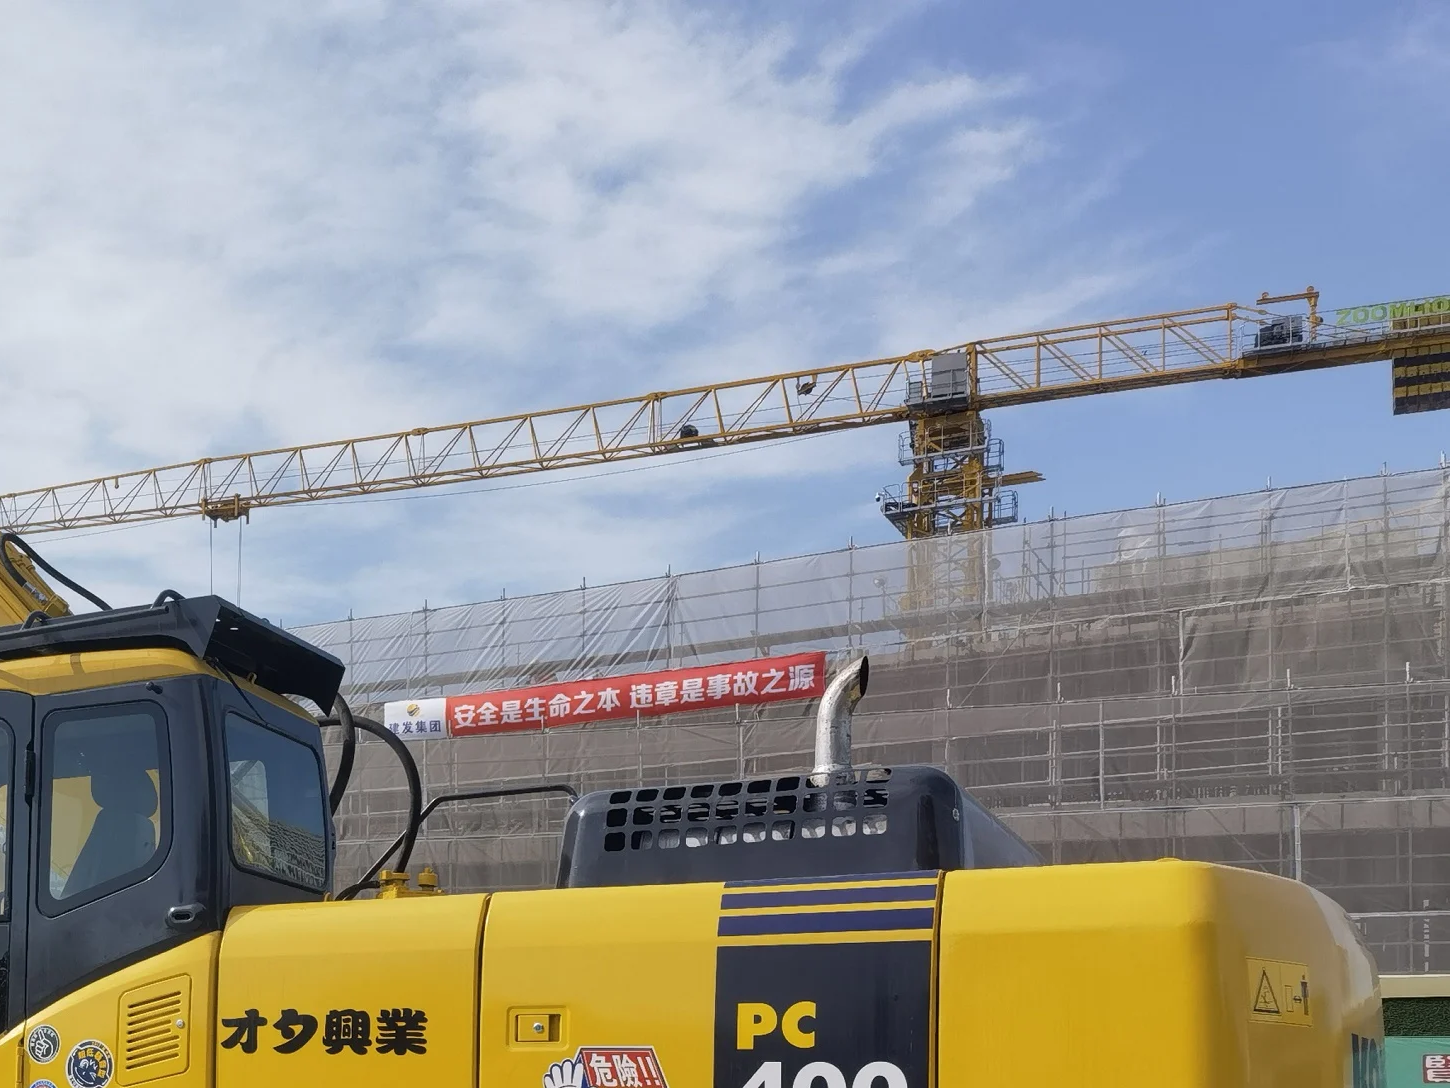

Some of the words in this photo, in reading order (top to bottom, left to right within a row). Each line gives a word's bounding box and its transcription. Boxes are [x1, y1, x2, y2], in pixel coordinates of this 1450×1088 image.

[454, 687, 621, 729] 安全是生命之本
[630, 664, 816, 710] 违章是事故之源
[389, 720, 442, 735] 建发集团
[736, 1000, 817, 1050] PC
